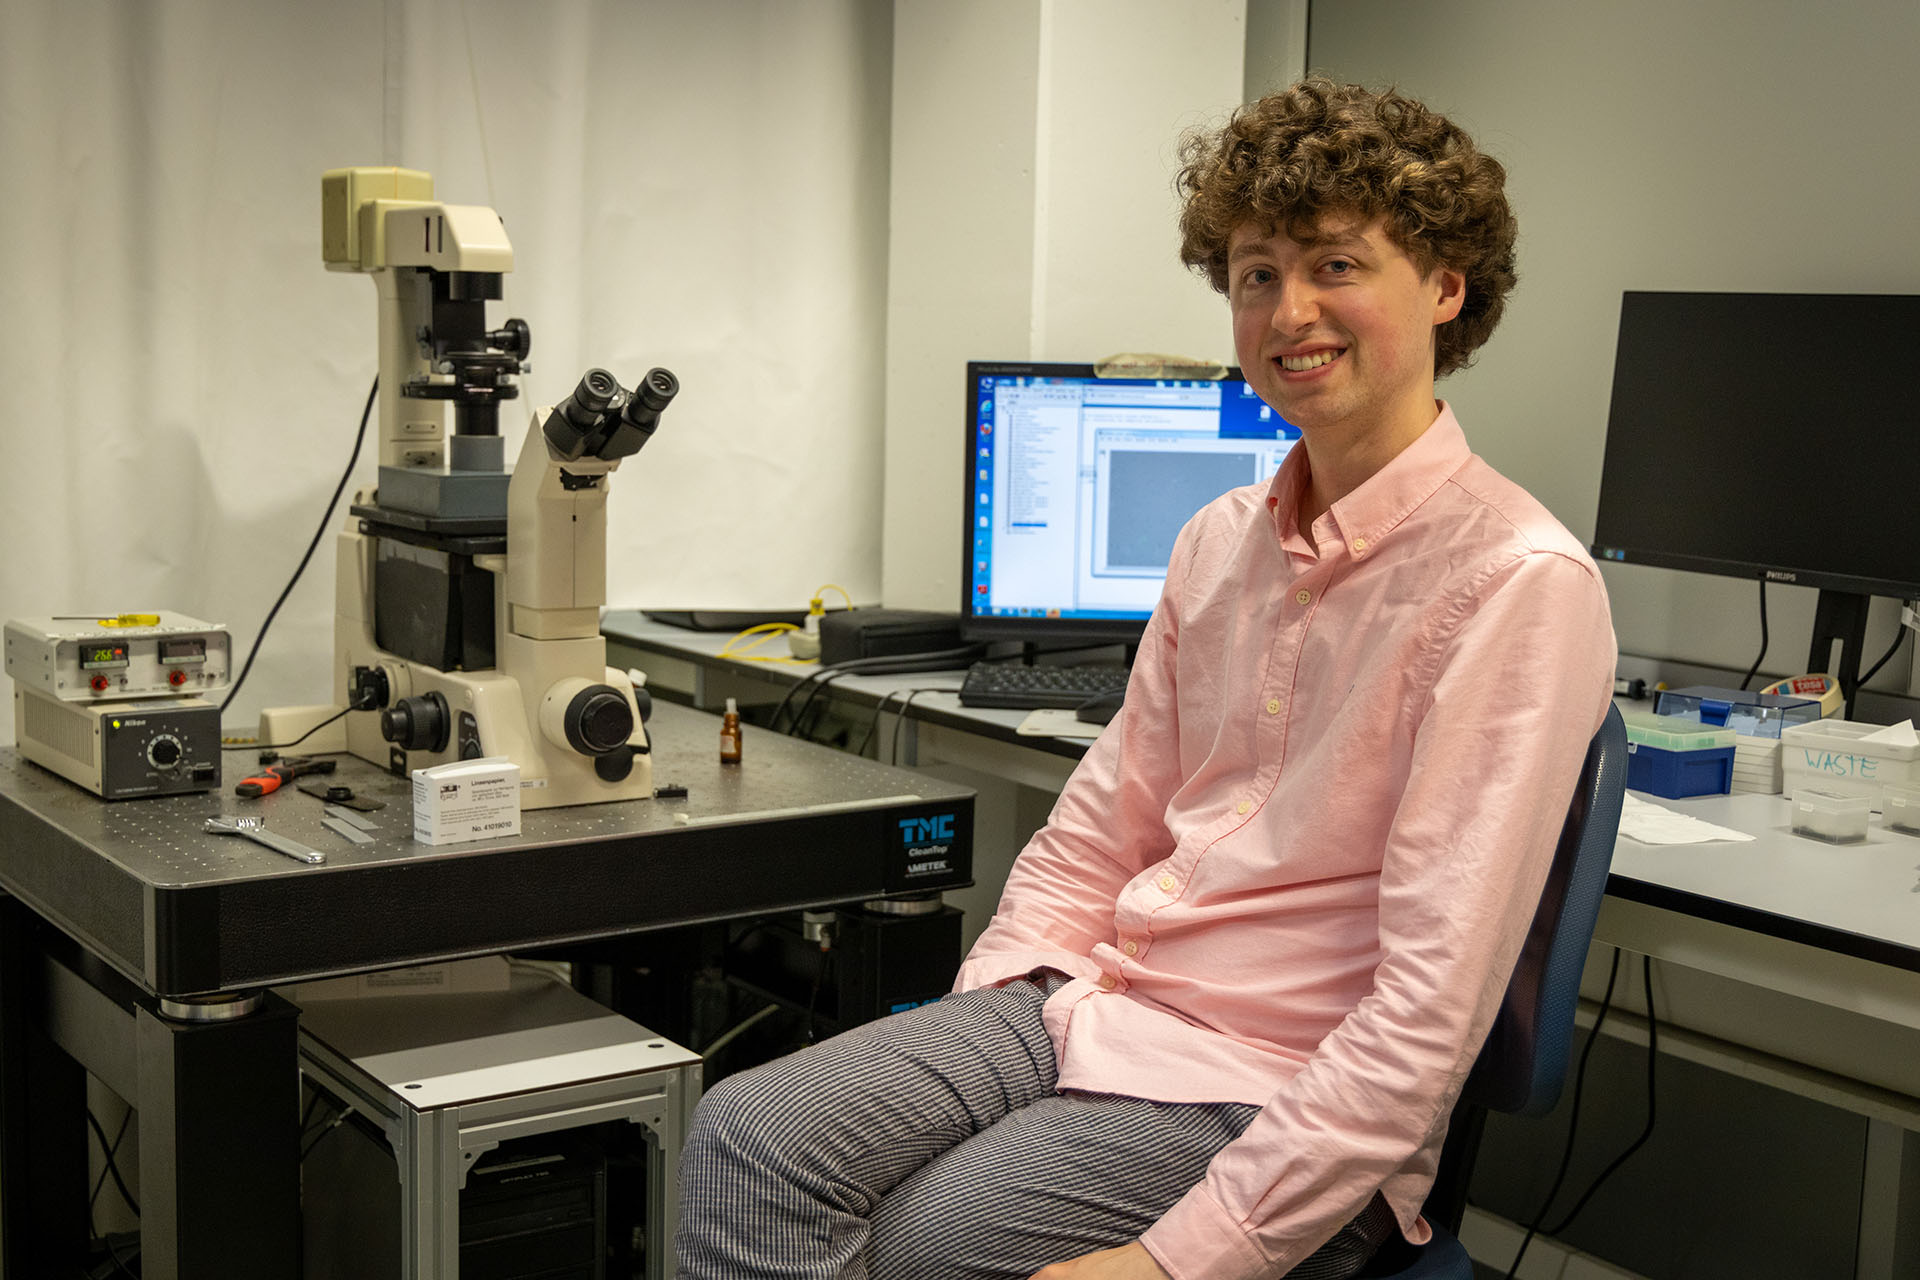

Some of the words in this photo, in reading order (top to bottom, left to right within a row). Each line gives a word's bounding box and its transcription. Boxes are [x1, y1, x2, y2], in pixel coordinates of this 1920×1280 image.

[1766, 571, 1796, 581] PHILIPS
[1804, 749, 1879, 778] WASTE
[472, 825, 482, 833] No.
[899, 814, 954, 842] TMC
[908, 845, 948, 857] CleanTop
[906, 860, 948, 873] AMETEK
